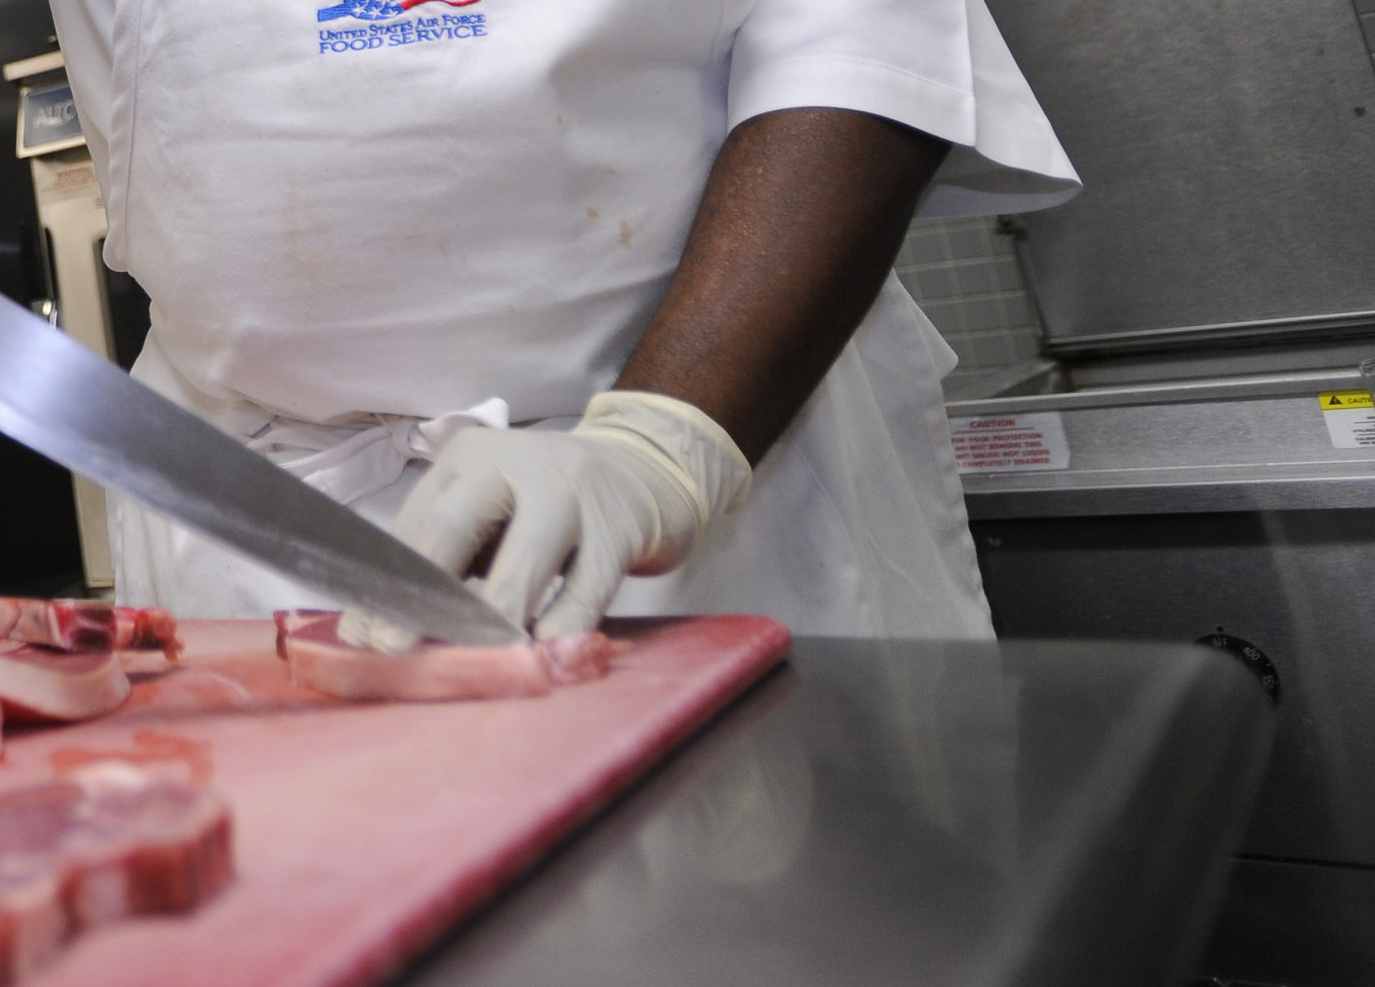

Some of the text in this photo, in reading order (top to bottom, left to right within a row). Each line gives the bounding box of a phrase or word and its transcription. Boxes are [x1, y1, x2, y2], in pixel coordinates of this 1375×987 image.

[319, 14, 487, 42] UNITED STATES AIR FORCE
[318, 24, 488, 54] FOOD SERVICE
[970, 419, 1016, 428] CAUTION
[993, 433, 1043, 441] PROTECTION
